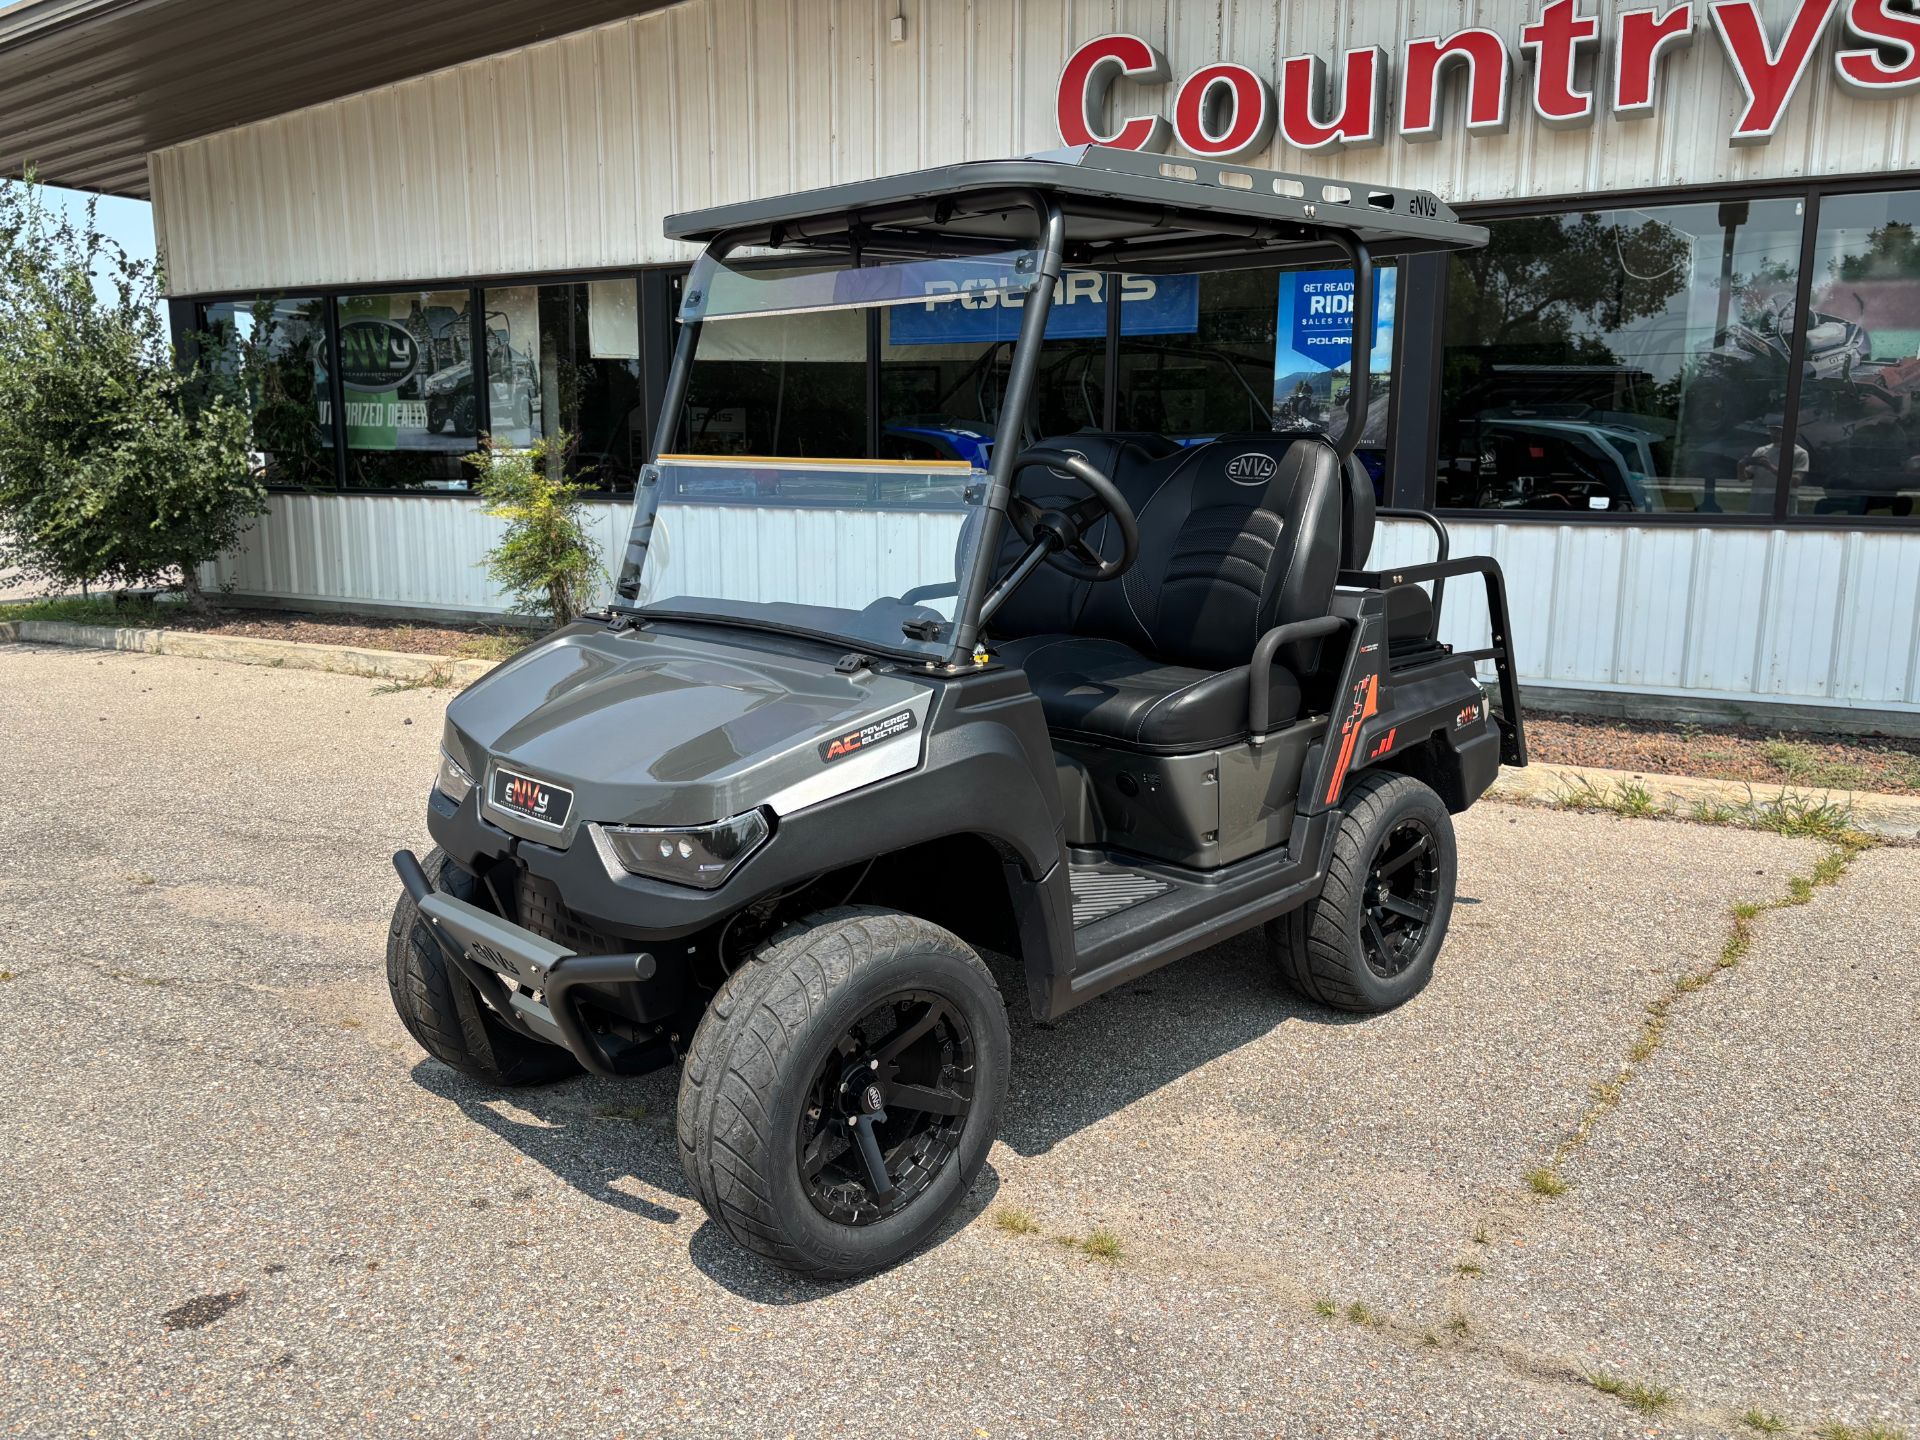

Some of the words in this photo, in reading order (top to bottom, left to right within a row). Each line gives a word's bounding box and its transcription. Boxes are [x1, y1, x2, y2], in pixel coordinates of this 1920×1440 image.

[1055, 0, 1920, 157] Countrys
[924, 273, 1156, 312] POLRS
[1303, 283, 1323, 293] GET
[1324, 282, 1355, 292] READY
[1301, 317, 1333, 326] SALES
[1307, 336, 1352, 345] POLARI
[387, 402, 429, 428] DEALER
[826, 730, 861, 759] AC
[860, 712, 910, 737] POWERED
[861, 720, 909, 745] ELECTRIC
